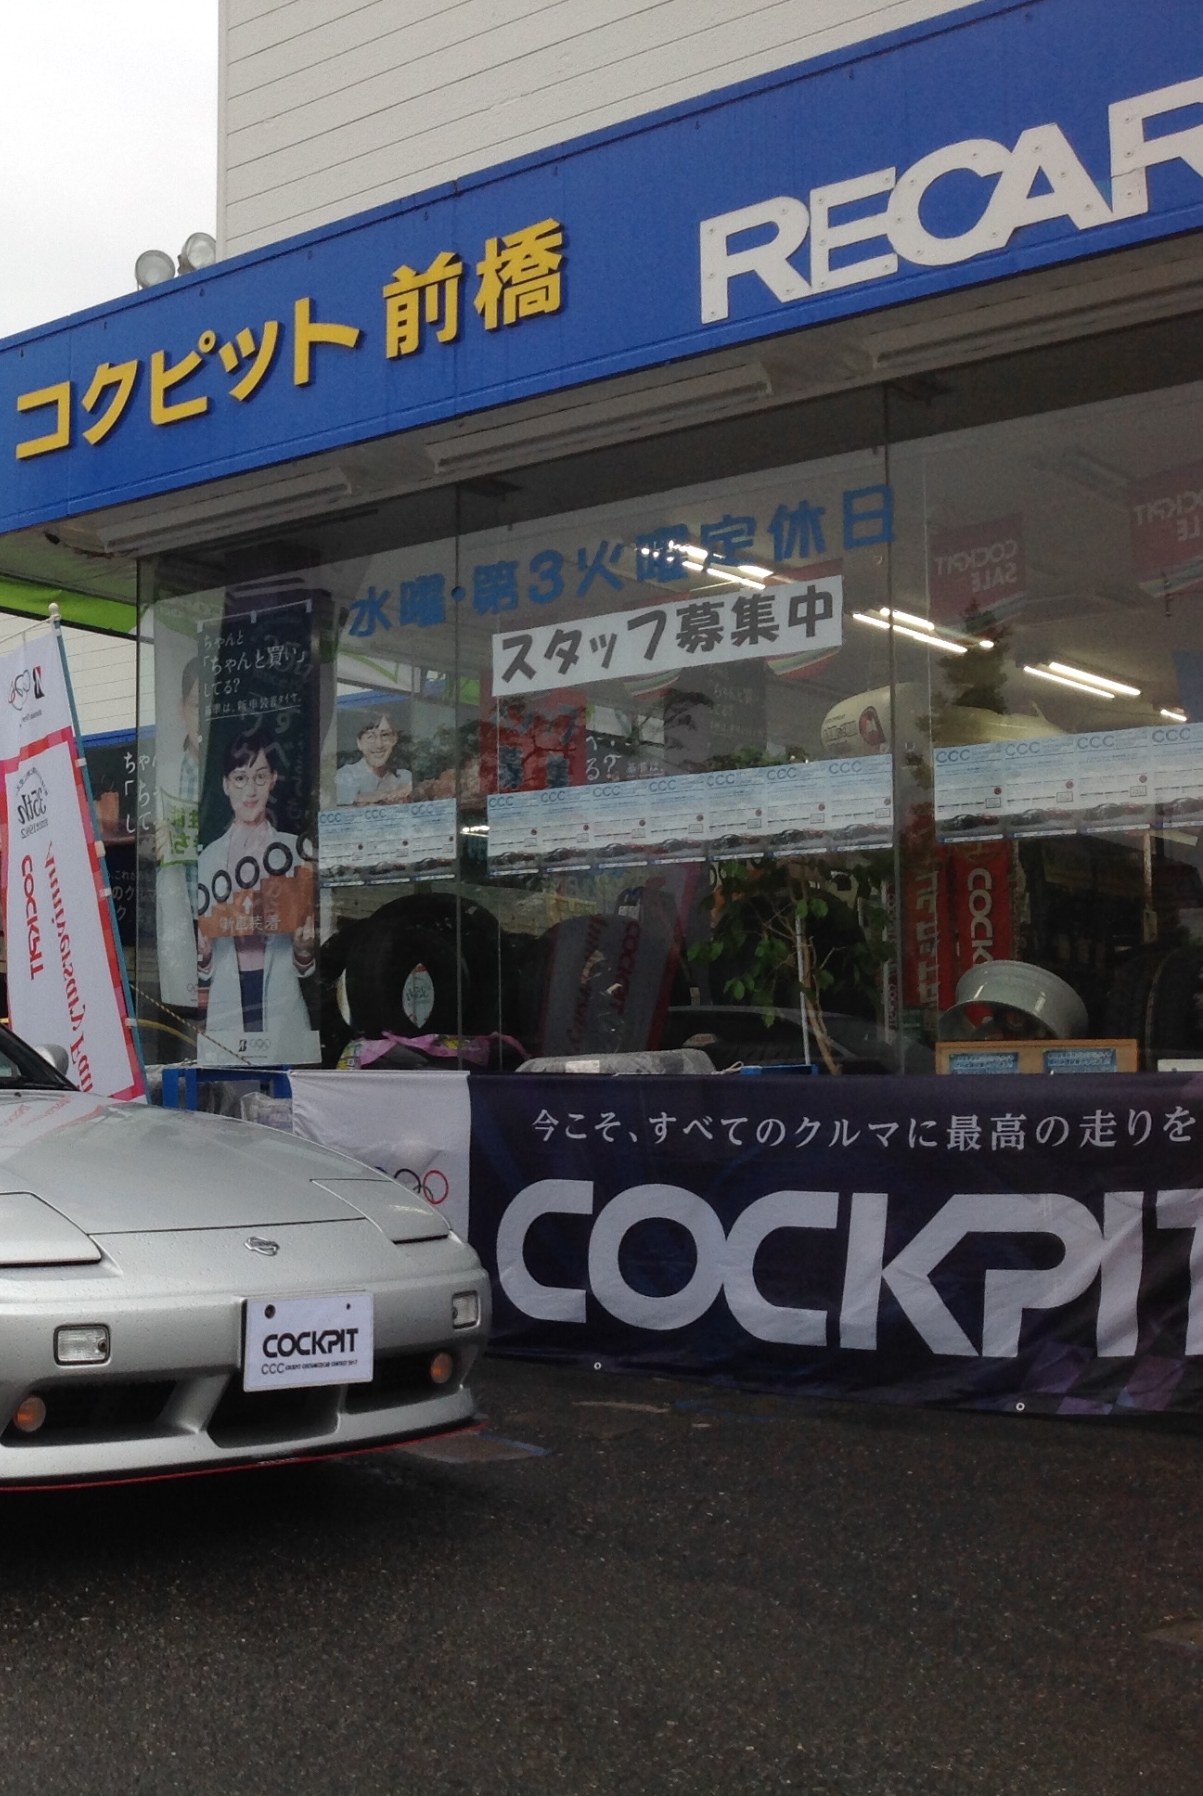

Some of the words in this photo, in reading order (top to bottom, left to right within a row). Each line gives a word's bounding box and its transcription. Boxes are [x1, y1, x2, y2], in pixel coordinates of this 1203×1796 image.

[699, 78, 1203, 326] RECAR
[13, 296, 362, 464] コクピット
[382, 216, 566, 362] 前橋
[204, 630, 244, 649] ちゃんと
[500, 584, 836, 688] スタッフ募集中
[203, 645, 306, 676] 「ちゃんと買い」
[1077, 735, 1115, 750] CCC
[1152, 727, 1191, 743] CCC
[936, 749, 971, 763] CCC
[1005, 741, 1040, 757] CCC
[767, 767, 797, 780] CCC
[829, 761, 862, 774] CCC
[649, 779, 677, 793] CCC
[706, 772, 735, 787] CCC
[540, 790, 566, 803] CCC
[592, 785, 621, 798] CCC
[489, 795, 514, 808] CCC
[365, 808, 387, 820] CCC
[411, 804, 434, 816] CCC
[320, 812, 342, 824] CCC
[967, 867, 993, 964] COCK
[532, 1105, 1194, 1153] 今こそ、すべてのクルマに最高の走りを
[262, 1328, 359, 1358] COCKPIT
[261, 1363, 285, 1375] CCC
